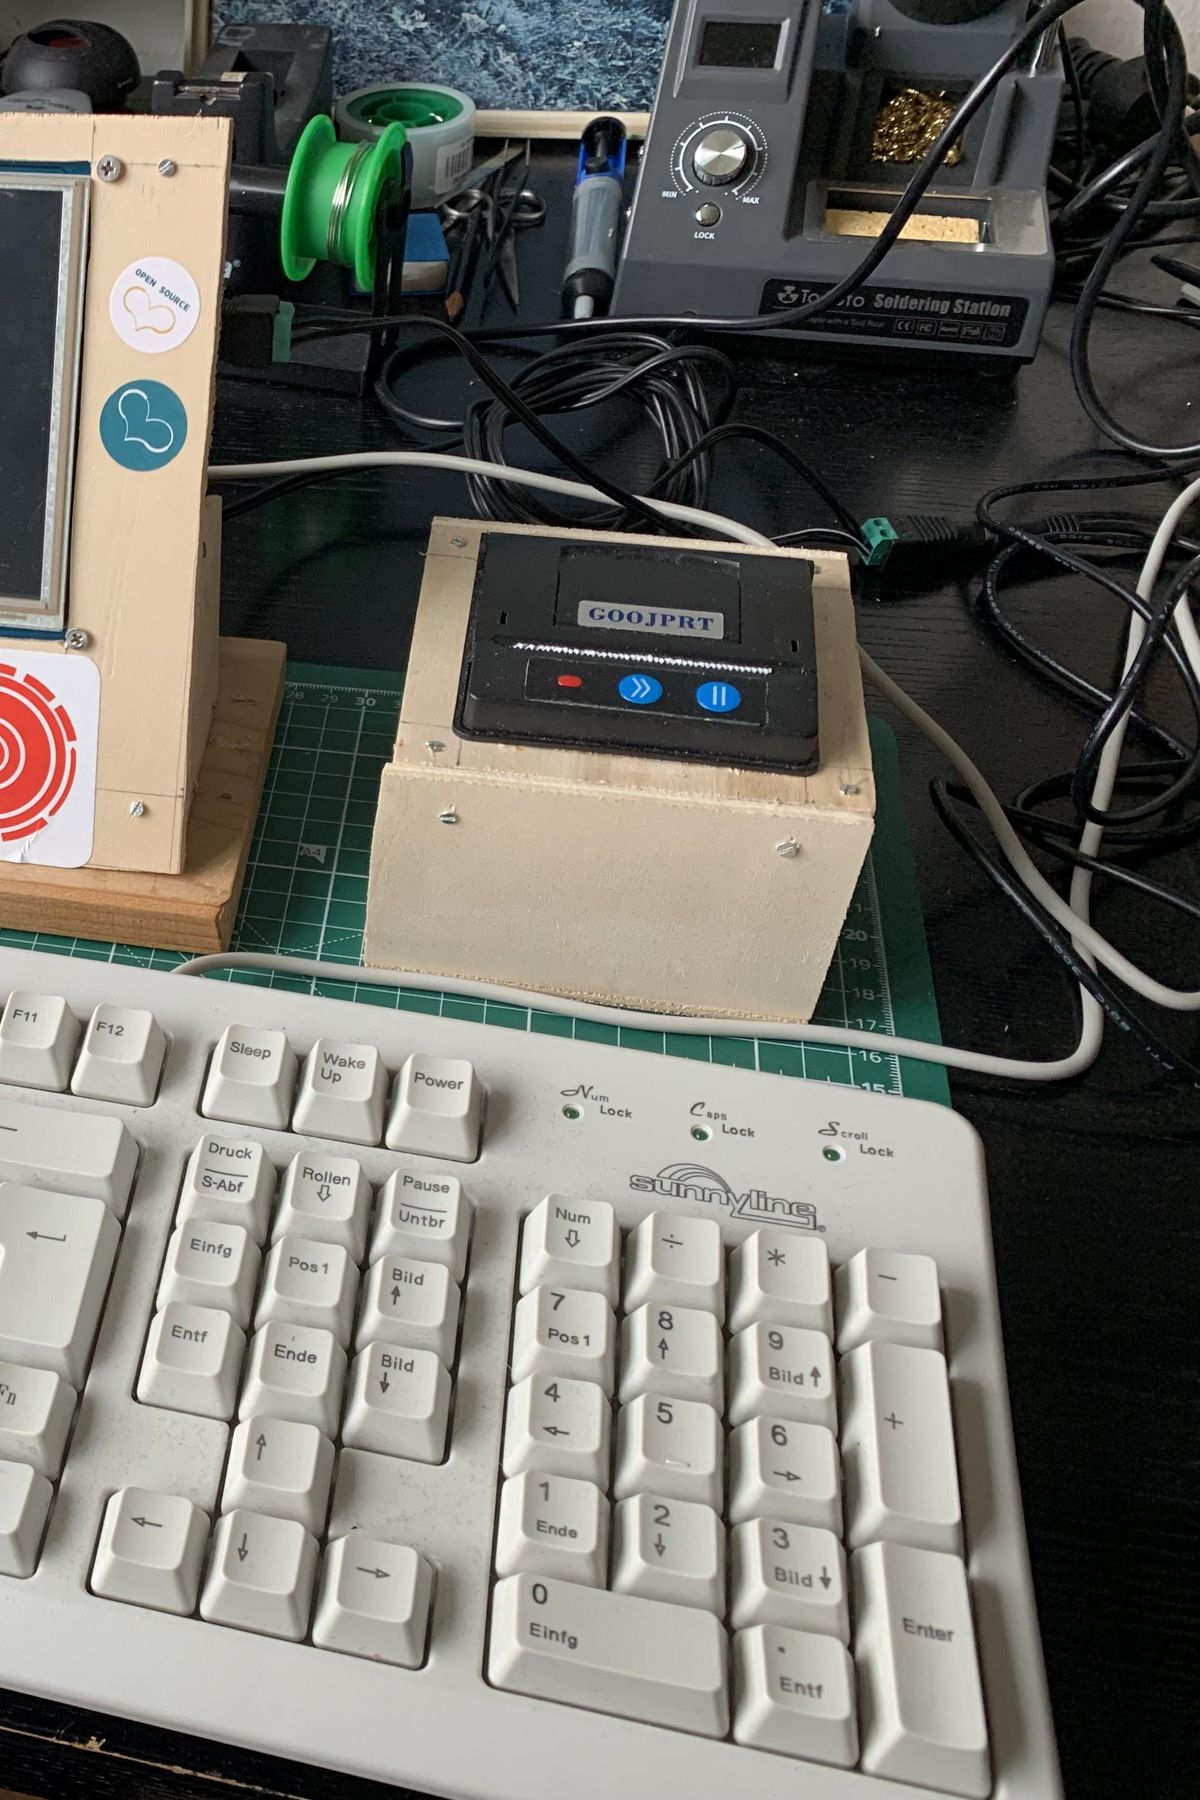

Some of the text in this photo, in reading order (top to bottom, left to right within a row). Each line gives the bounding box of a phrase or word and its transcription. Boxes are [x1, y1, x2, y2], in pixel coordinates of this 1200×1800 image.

[661, 190, 678, 198] MIN
[742, 196, 760, 205] MAX
[694, 231, 715, 240] LOCK
[135, 268, 190, 312] OPEN SOURCE
[801, 288, 1012, 318] Toto Soldering Station
[588, 607, 714, 631] GOOJPRT
[321, 693, 339, 703] 29
[355, 696, 376, 707] 30
[845, 929, 868, 942] 20
[849, 958, 871, 971] 19
[853, 987, 875, 1001] 18
[12, 1008, 38, 1023] F11
[856, 1018, 877, 1032] 17
[95, 1020, 125, 1037] F12
[229, 1041, 272, 1061] Sleep
[322, 1051, 367, 1069] Wake
[858, 1049, 882, 1064] 16
[320, 1066, 342, 1085] Up
[413, 1071, 465, 1090] Power
[861, 1082, 885, 1095] 15
[559, 1084, 632, 1119] Num Lock
[689, 1101, 755, 1138] Caps Lock
[817, 1121, 894, 1158] Scroll Lock
[208, 1141, 253, 1160] Druck
[201, 1175, 244, 1194] S-Abf
[302, 1166, 351, 1186] Rollen
[402, 1174, 451, 1194] Pause
[398, 1213, 447, 1230] Untbr
[555, 1206, 591, 1225] Num
[190, 1238, 233, 1259] Einfg
[392, 1267, 425, 1287] Bild
[550, 1292, 566, 1312] 7
[657, 1310, 674, 1331] 8
[171, 1324, 209, 1344] Entf
[767, 1330, 784, 1351] 9
[273, 1343, 318, 1364] Ende
[380, 1353, 415, 1373] Bild
[768, 1366, 805, 1386] Bild
[543, 1382, 561, 1403] 4
[656, 1401, 673, 1425] 5
[770, 1424, 788, 1447] 6
[538, 1481, 550, 1502] 1
[653, 1504, 671, 1528] 2
[536, 1519, 578, 1539] Ende
[772, 1527, 790, 1550] 3
[774, 1566, 814, 1589] Bild
[529, 1621, 578, 1650] Einfg
[901, 1617, 955, 1642] Enter
[779, 1675, 823, 1699] Entf
